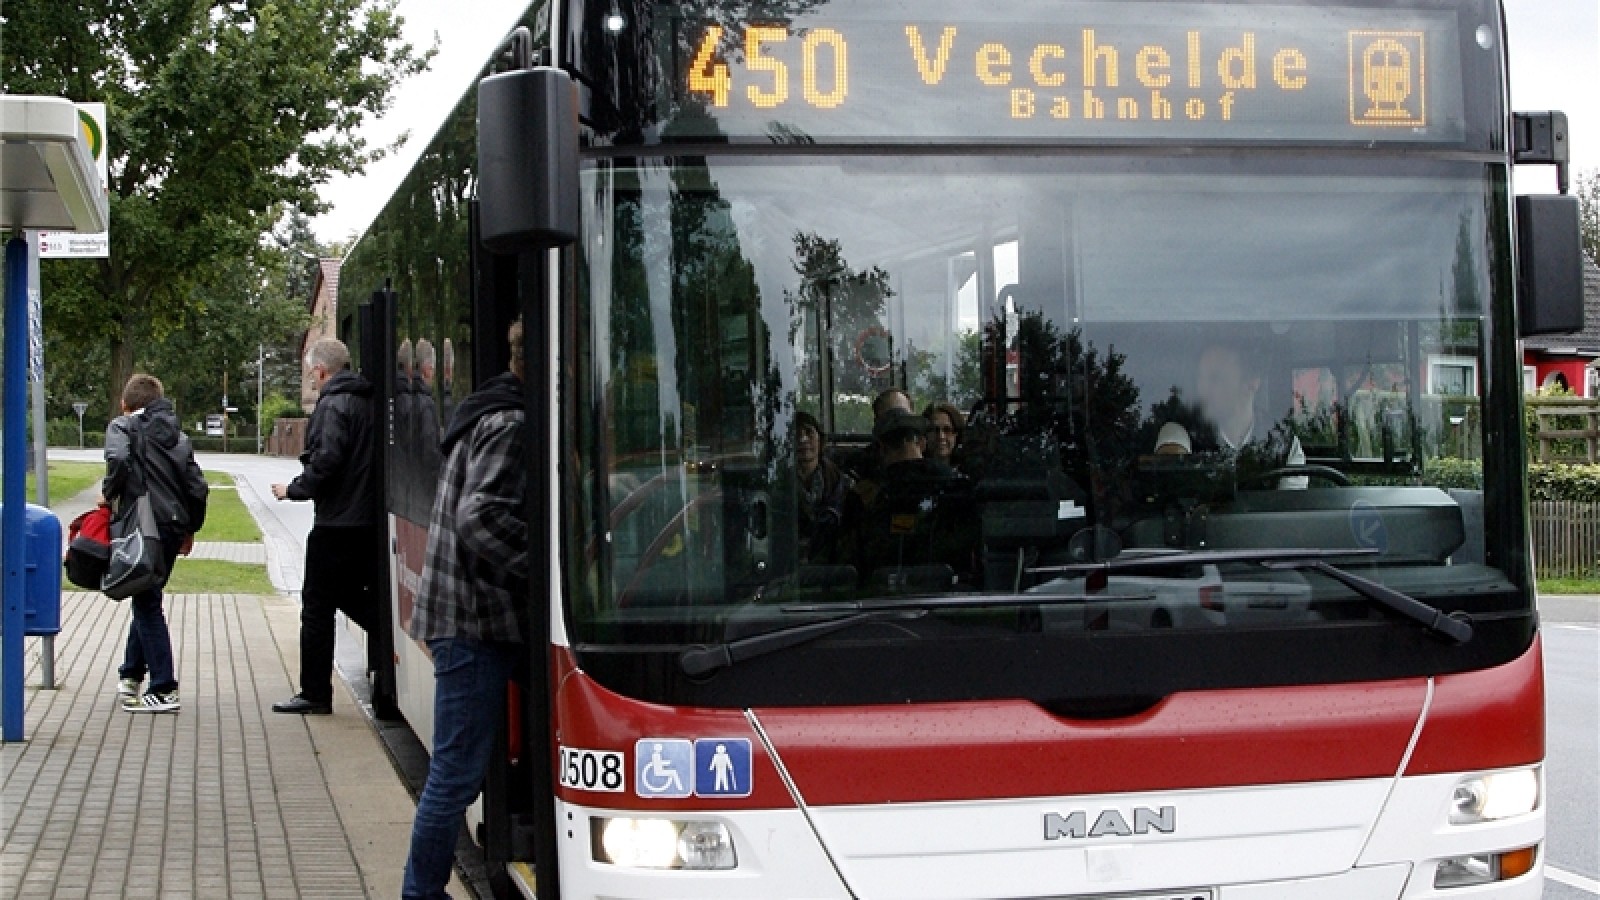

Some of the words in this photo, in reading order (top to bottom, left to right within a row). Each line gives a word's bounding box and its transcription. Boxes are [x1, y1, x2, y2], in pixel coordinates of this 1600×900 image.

[687, 25, 848, 108] 450
[905, 25, 1307, 89] Vechelde
[1010, 88, 1235, 119] Bahnhof
[1043, 806, 1176, 840] MAN
